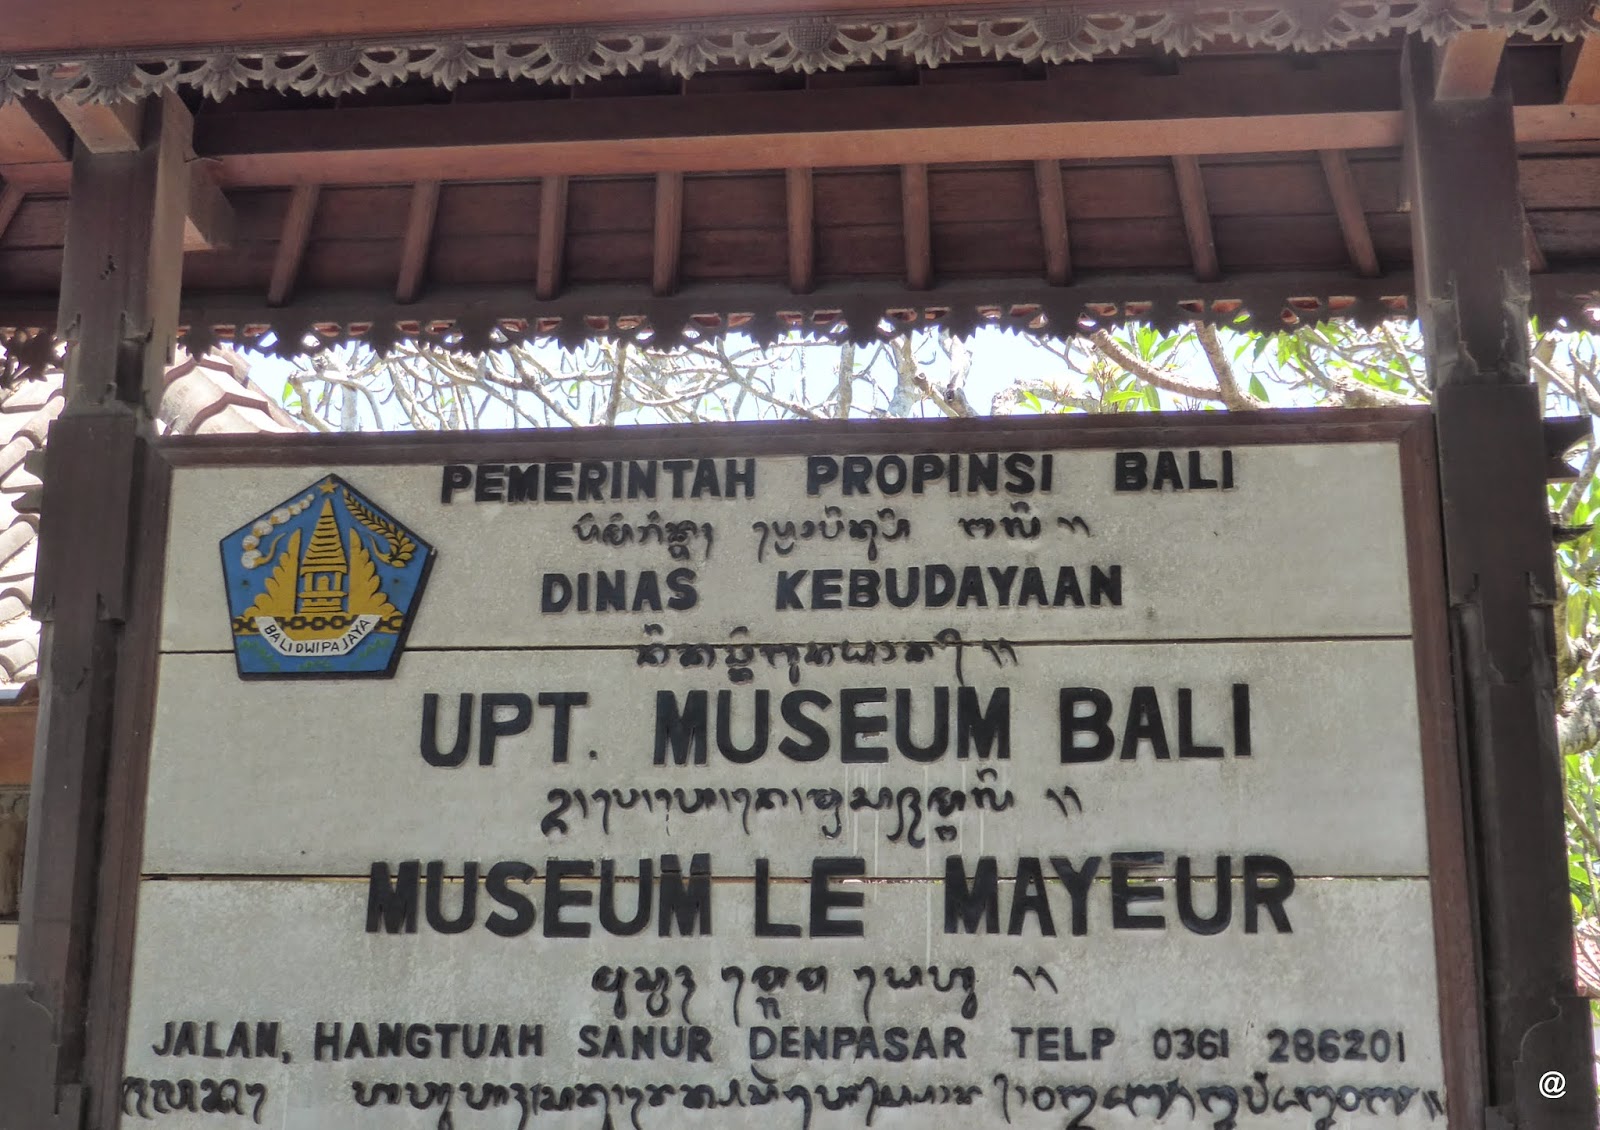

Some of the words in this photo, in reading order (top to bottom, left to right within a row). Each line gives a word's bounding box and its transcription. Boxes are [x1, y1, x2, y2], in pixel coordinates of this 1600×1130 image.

[441, 459, 755, 504] PEMERINTAH
[806, 452, 1053, 497] PROPINSI
[1114, 446, 1235, 491] BALI
[541, 568, 697, 613] DINAS
[776, 564, 1122, 610] KEBUDAYAAN
[263, 623, 293, 653] BALI
[296, 641, 341, 653] DWIPA
[342, 618, 372, 650] JAYA
[420, 692, 596, 768] UPT.
[654, 686, 1010, 767] MUSEUM
[1059, 683, 1251, 763] BALI
[366, 854, 711, 937] MUSEUM
[754, 857, 867, 938] LE
[944, 851, 1295, 936] MAYEUR
[152, 1022, 291, 1064] JALAN,
[314, 1022, 543, 1060] HANGTUAH
[578, 1025, 712, 1062] SANUR
[750, 1025, 966, 1062] DENPASAR
[1011, 1027, 1115, 1061] TELP
[1153, 1027, 1230, 1060] 0361
[1267, 1028, 1406, 1063] 286201
